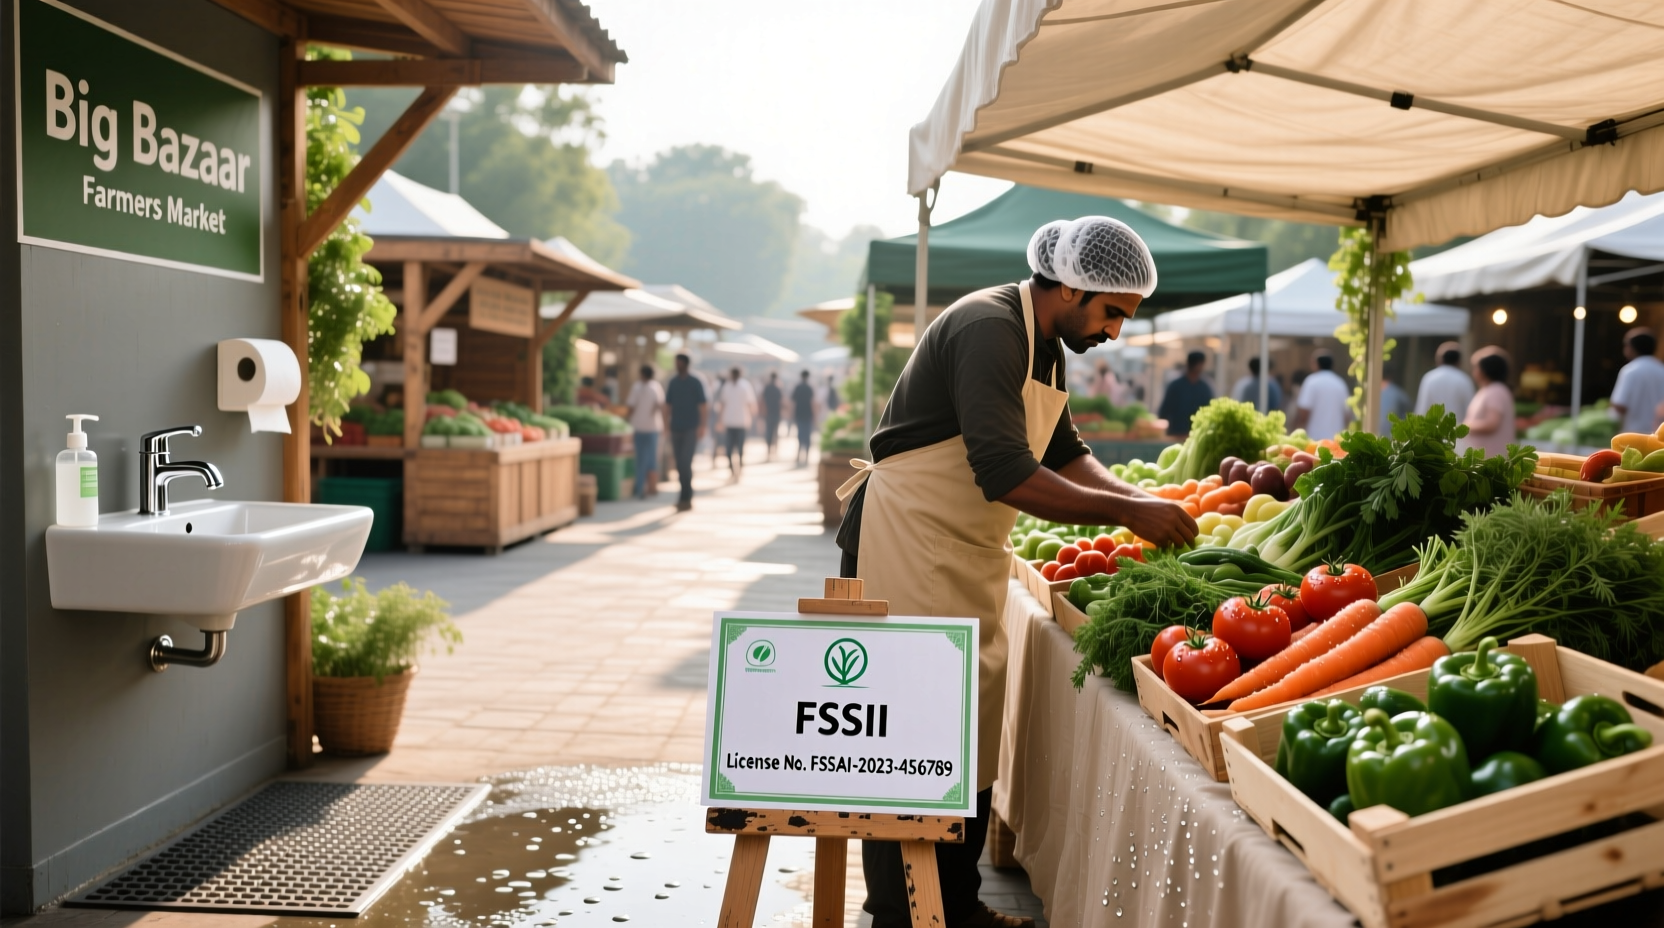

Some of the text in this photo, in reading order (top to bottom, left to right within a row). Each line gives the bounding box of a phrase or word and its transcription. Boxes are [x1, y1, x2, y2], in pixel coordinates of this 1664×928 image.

[46, 68, 251, 193] Big Bazaar
[83, 175, 226, 235] Farmers Market
[795, 701, 888, 738] FSSII
[726, 752, 953, 777] License No. FSSAI-2023-456789
